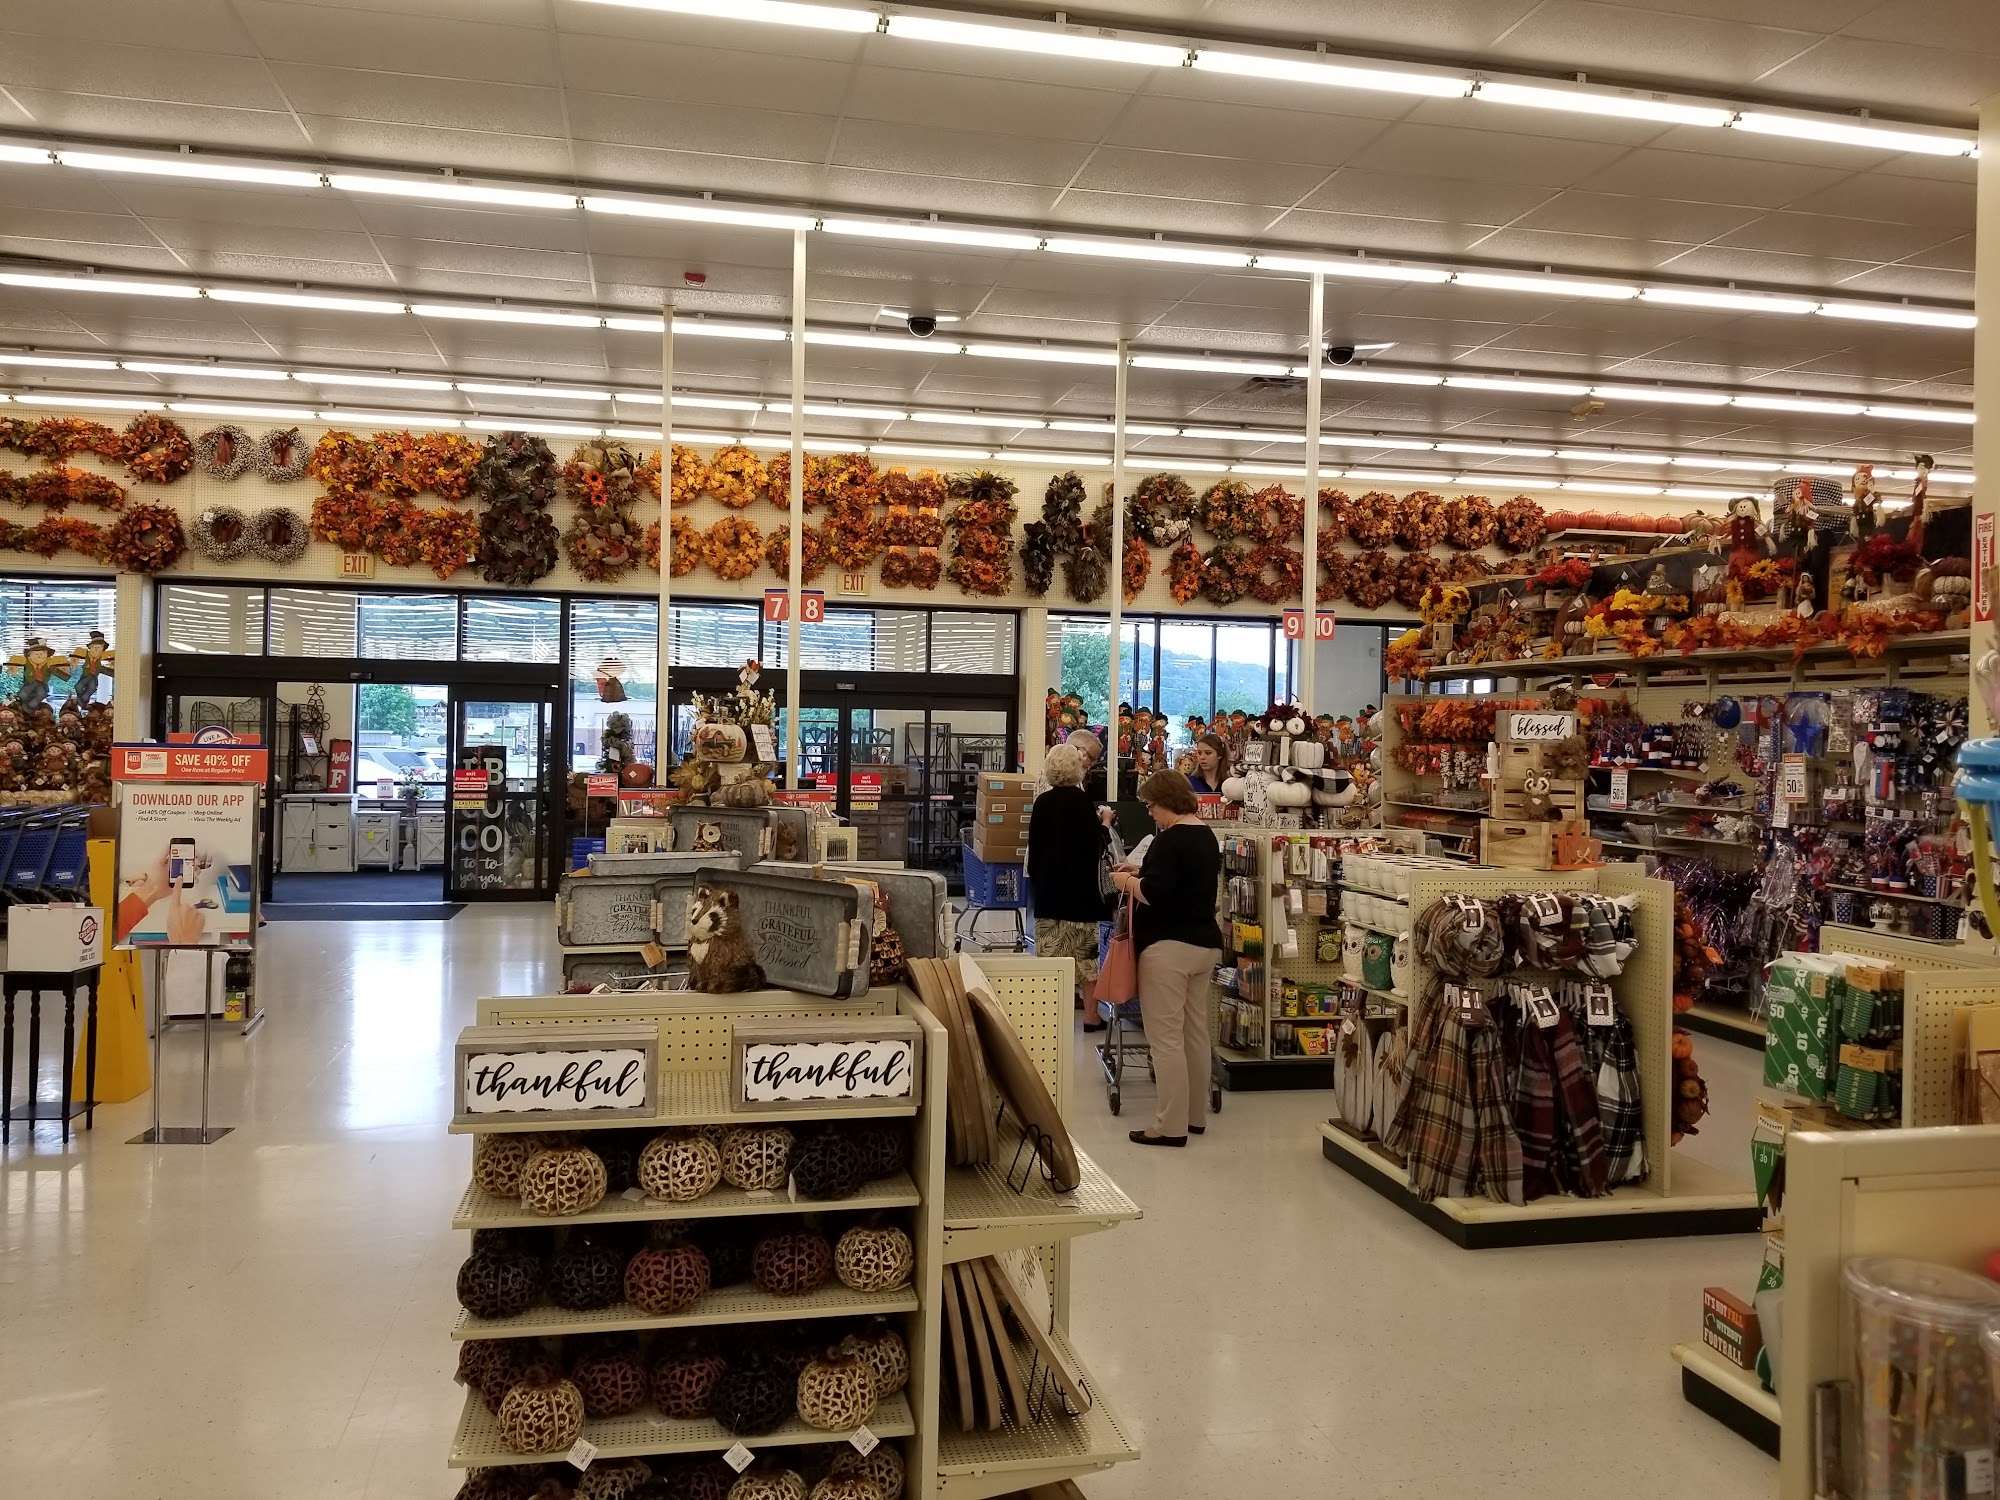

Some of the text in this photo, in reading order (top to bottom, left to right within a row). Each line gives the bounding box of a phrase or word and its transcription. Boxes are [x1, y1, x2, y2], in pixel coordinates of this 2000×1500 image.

[1978, 522, 1992, 533] FIRE
[344, 555, 368, 573] EXIT
[843, 574, 865, 591] EXIT
[770, 597, 783, 618] 7
[805, 599, 819, 619] 8
[1287, 616, 1299, 636] 9
[1315, 617, 1333, 637] 10
[1517, 716, 1565, 736] blessed
[203, 735, 215, 743] LIVE
[174, 754, 251, 767] SAVE 40% OFF
[331, 751, 350, 765] Hello
[211, 767, 232, 775] Regular
[330, 769, 346, 789] F
[1612, 788, 1620, 800] 50
[1786, 779, 1797, 793] 50
[133, 793, 245, 807] DOWNLOAD OUR APP
[479, 857, 503, 869] to
[764, 901, 813, 919] THANKFUL
[761, 918, 814, 940] GRATEFUL
[767, 934, 805, 953] AND TRULY
[757, 942, 812, 969] Blessed
[1770, 1003, 1785, 1018] 50
[1796, 1030, 1808, 1051] 10
[751, 1049, 905, 1091] thankful
[474, 1059, 640, 1103] thankful
[1759, 1153, 1768, 1164] 30
[1767, 1275, 1777, 1288] 30
[1704, 1291, 1744, 1329] IT'S NOT FALL
[1715, 1318, 1743, 1346] WITHOUT
[1704, 1326, 1743, 1368] FOOTBALL
